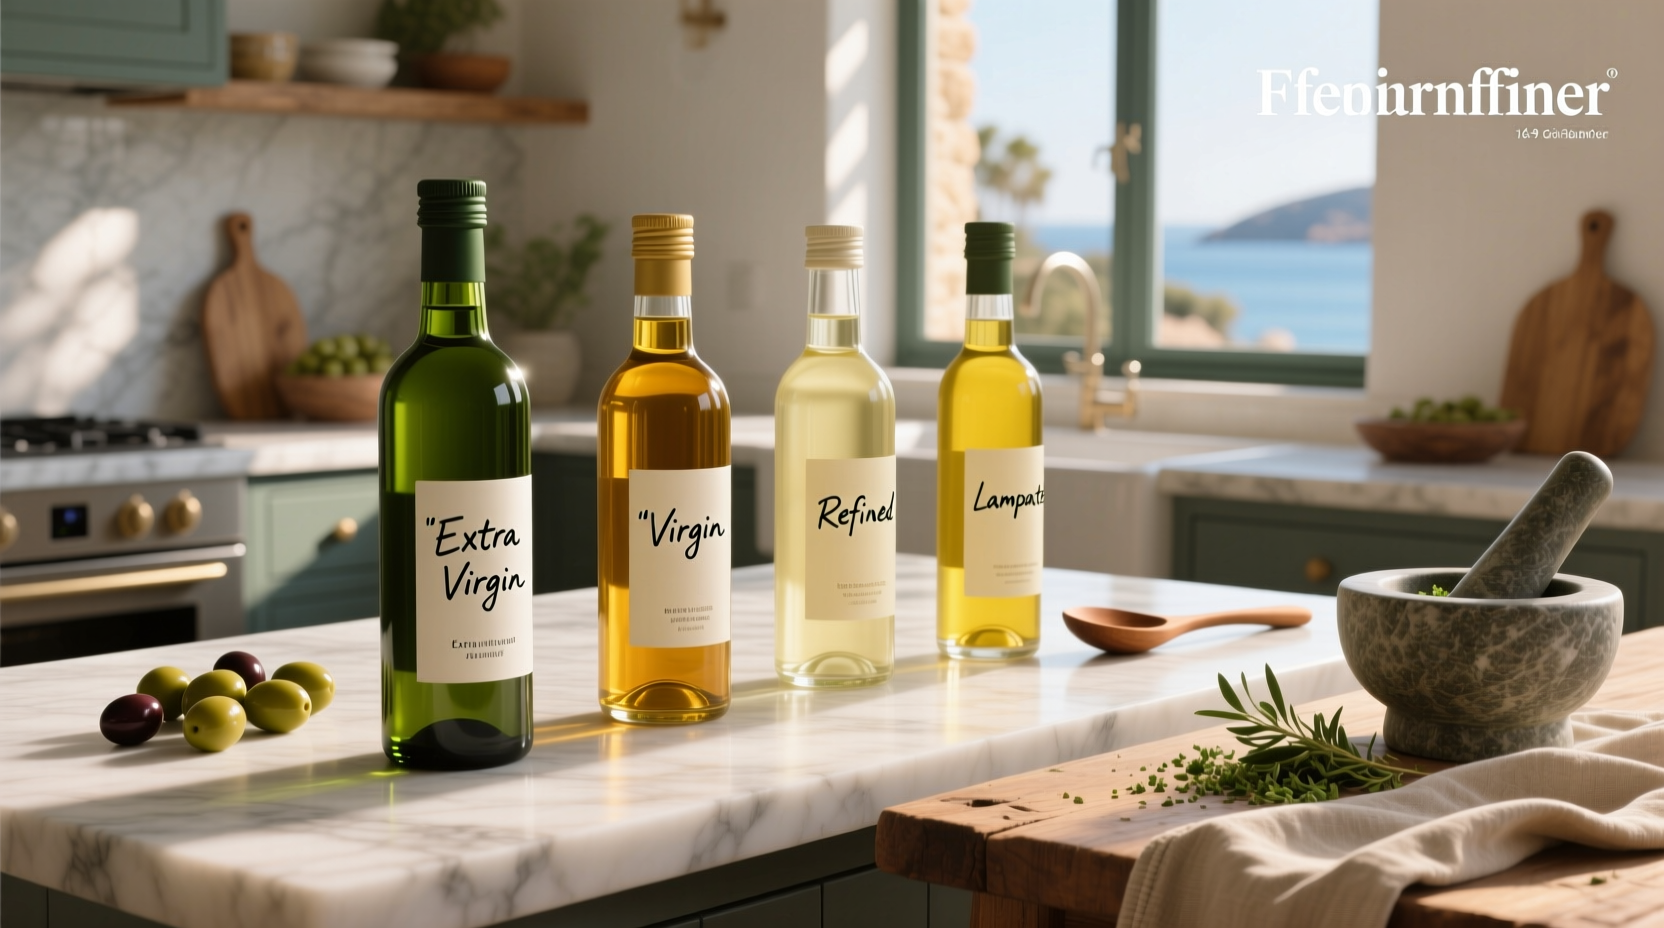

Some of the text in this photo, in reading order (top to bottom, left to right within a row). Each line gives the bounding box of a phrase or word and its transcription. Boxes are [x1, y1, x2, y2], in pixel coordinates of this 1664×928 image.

[426, 515, 520, 556] "Extra
[638, 508, 725, 560] "Virgin
[818, 491, 895, 537] Refined
[444, 561, 525, 612] Virgin
